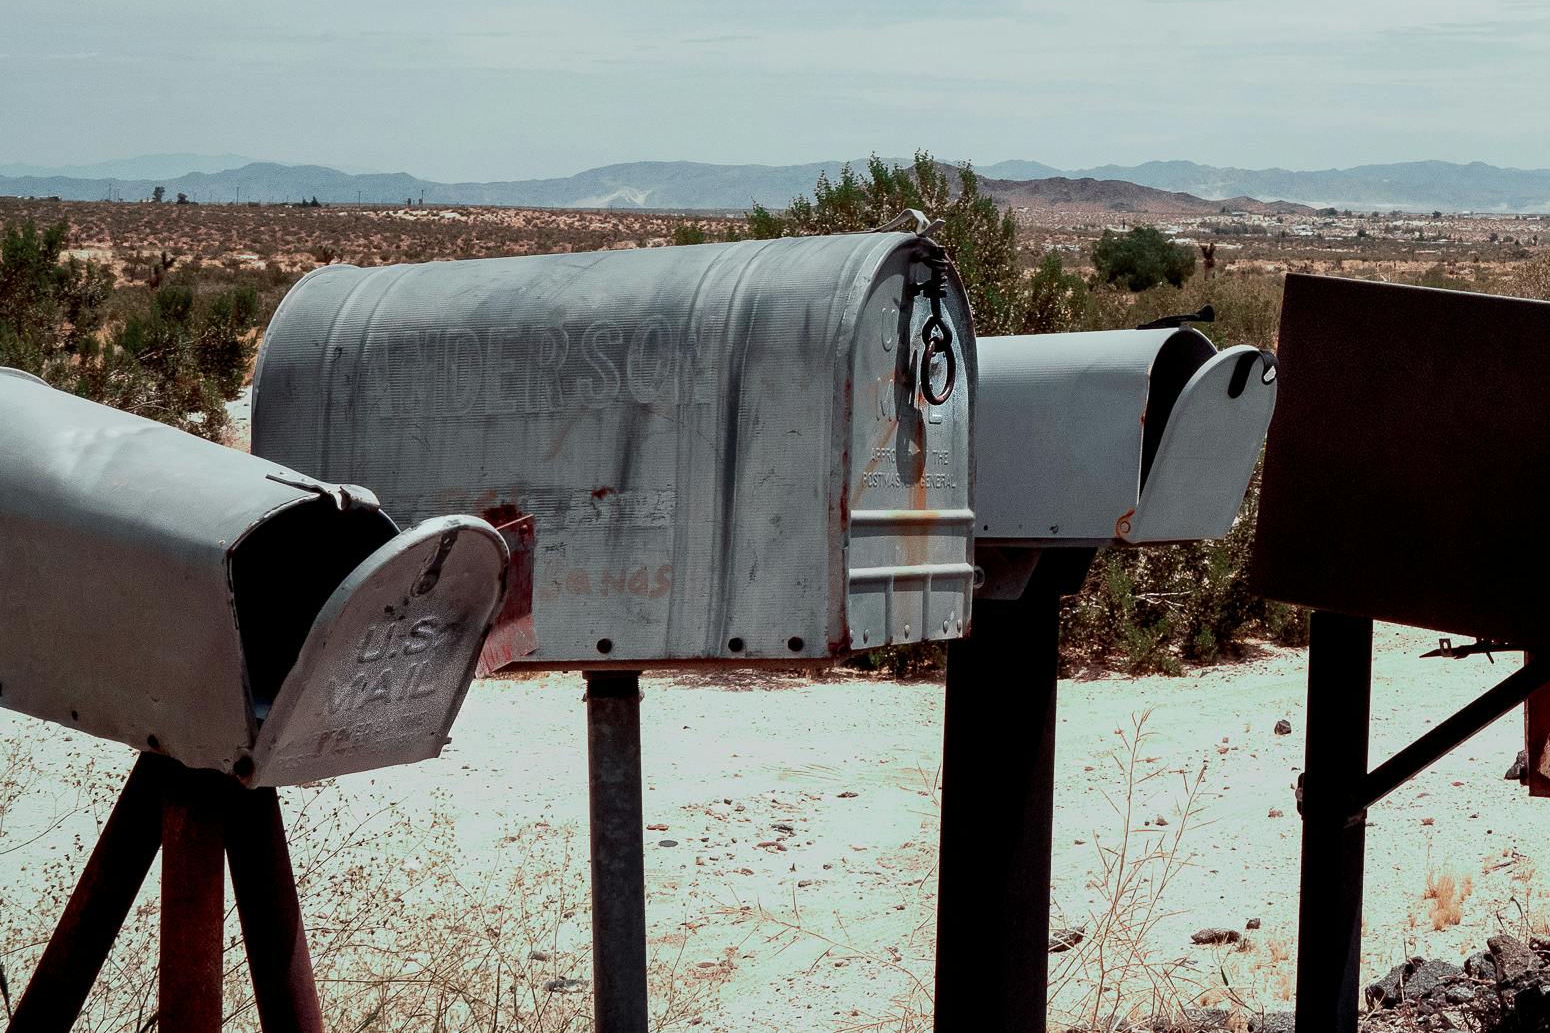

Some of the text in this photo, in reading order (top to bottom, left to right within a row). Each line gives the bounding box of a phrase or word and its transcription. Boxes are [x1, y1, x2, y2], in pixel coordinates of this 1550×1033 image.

[366, 313, 716, 418] ANDERSON
[920, 472, 957, 489] GENERAL
[327, 660, 438, 717] MAIL
